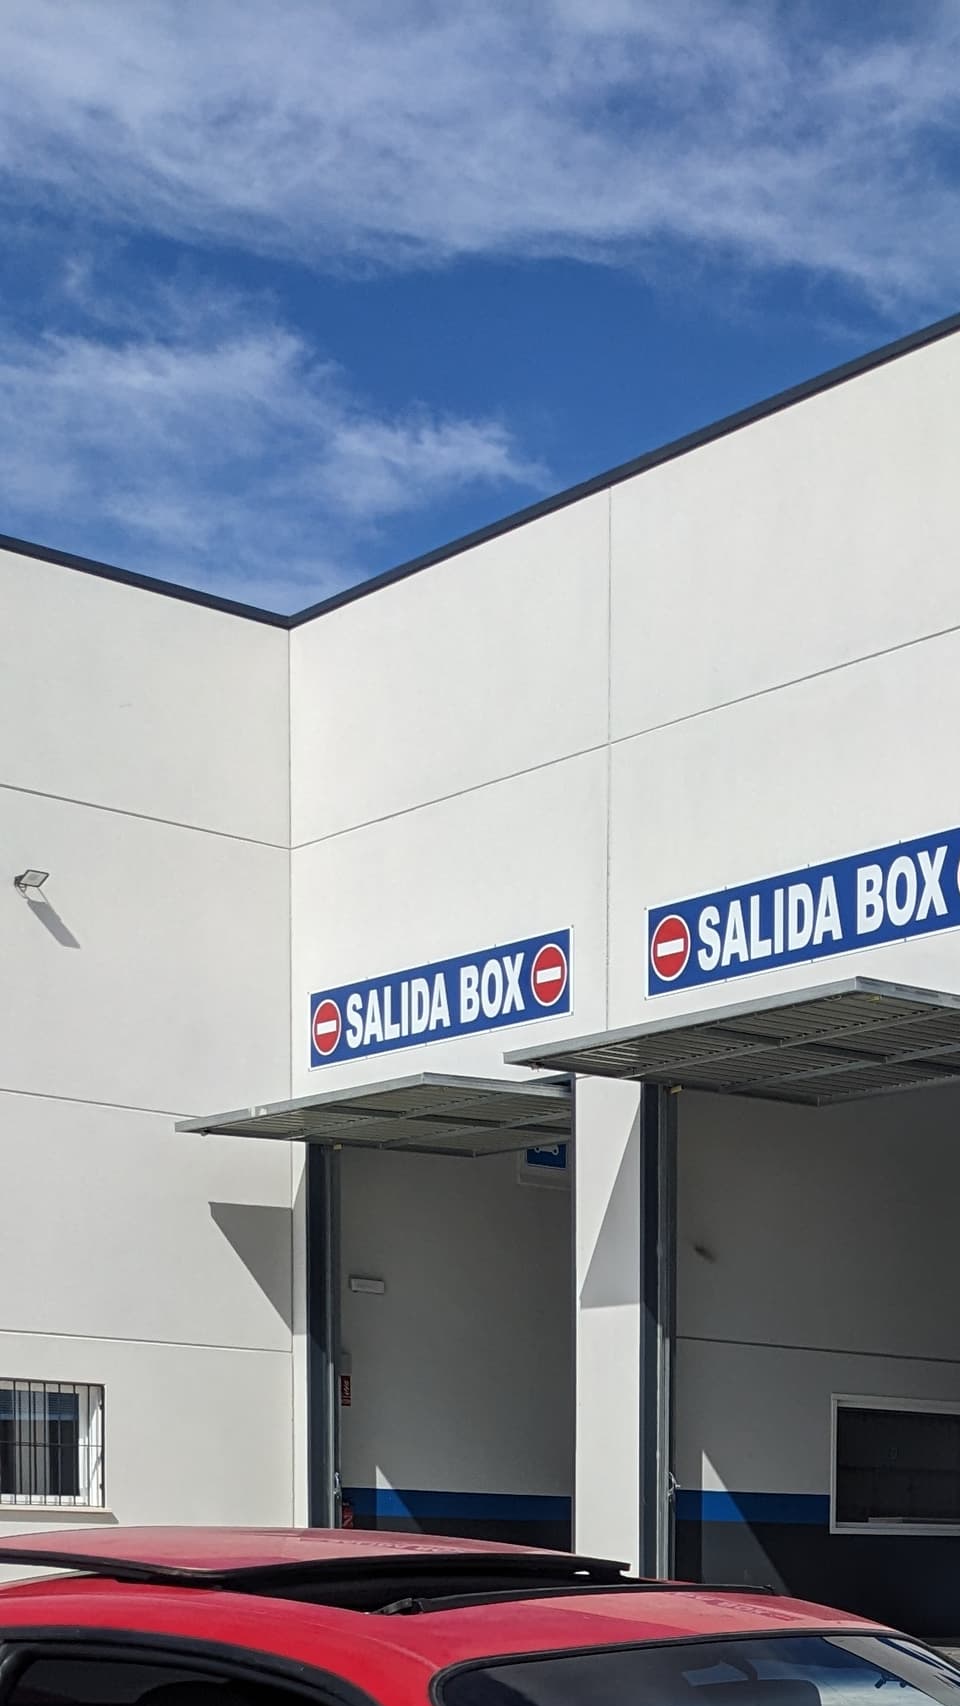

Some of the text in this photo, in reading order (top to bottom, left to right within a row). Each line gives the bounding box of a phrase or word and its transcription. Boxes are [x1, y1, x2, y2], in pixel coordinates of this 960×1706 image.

[697, 845, 949, 971] SALIDA BOX
[345, 952, 526, 1049] SALIDA BOX
